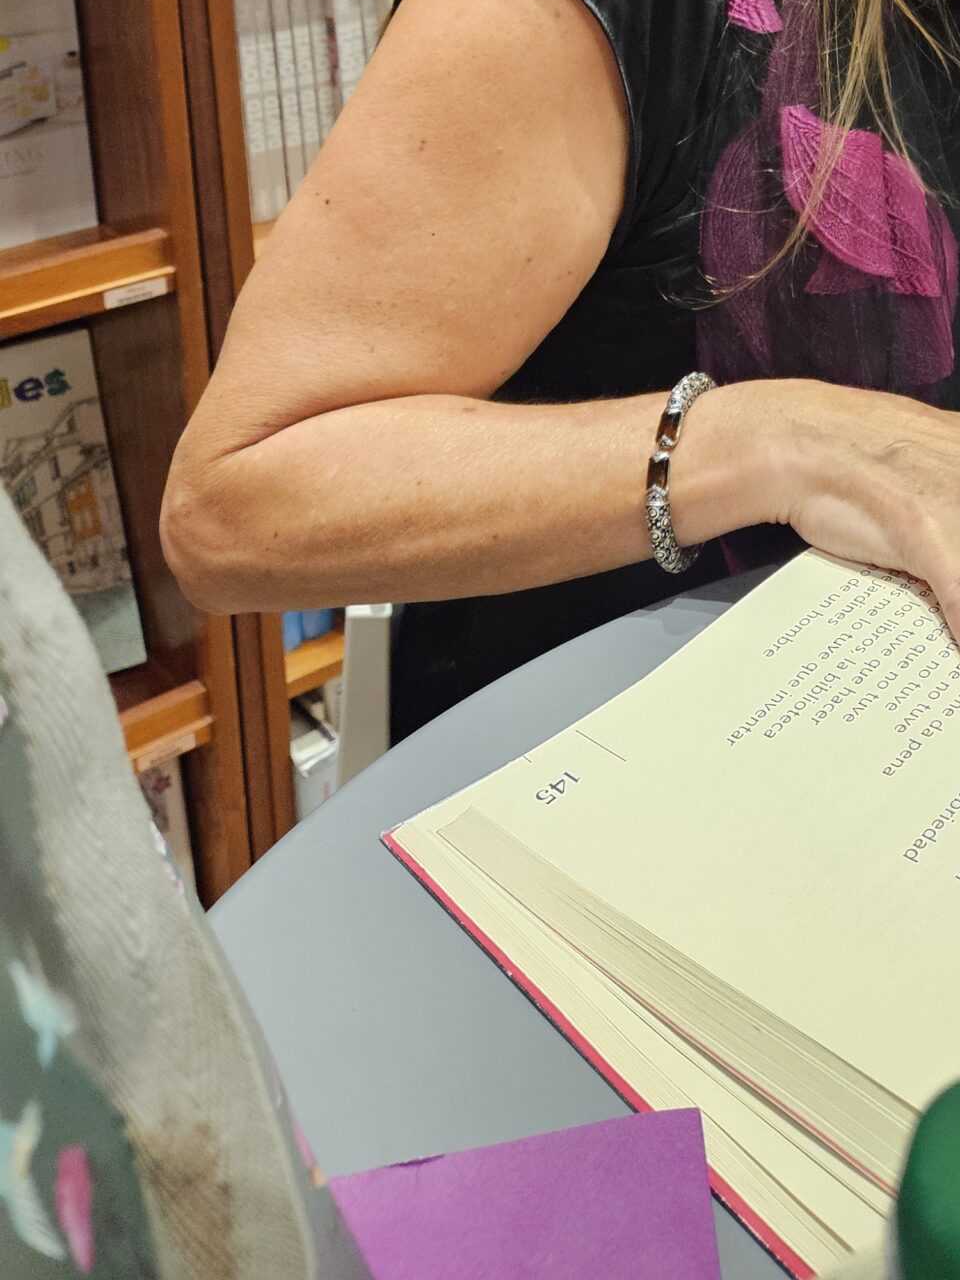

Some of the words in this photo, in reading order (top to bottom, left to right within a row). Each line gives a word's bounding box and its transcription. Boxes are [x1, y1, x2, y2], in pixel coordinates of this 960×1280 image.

[839, 578, 860, 593] de
[818, 593, 841, 609] un
[827, 579, 886, 626] jardines
[866, 598, 892, 617] me
[893, 595, 922, 618] los
[762, 610, 825, 658] hombre
[851, 618, 872, 631] lo
[912, 613, 934, 628] lo
[817, 632, 854, 660] tuve
[849, 618, 900, 654] libros,
[880, 629, 916, 657] tuve
[835, 658, 857, 671] la
[897, 644, 927, 669] que
[918, 660, 940, 679] no
[787, 662, 819, 688] que
[850, 658, 881, 685] que
[876, 671, 900, 690] no
[884, 681, 922, 712] tuve
[927, 681, 951, 700] no
[726, 689, 793, 747] inventar
[762, 672, 842, 739] biblioteca
[810, 686, 857, 726] hacer
[842, 692, 880, 723] tuve
[894, 703, 932, 733] tuve
[920, 719, 943, 738] da
[881, 738, 923, 777] pena
[533, 768, 580, 806] 145
